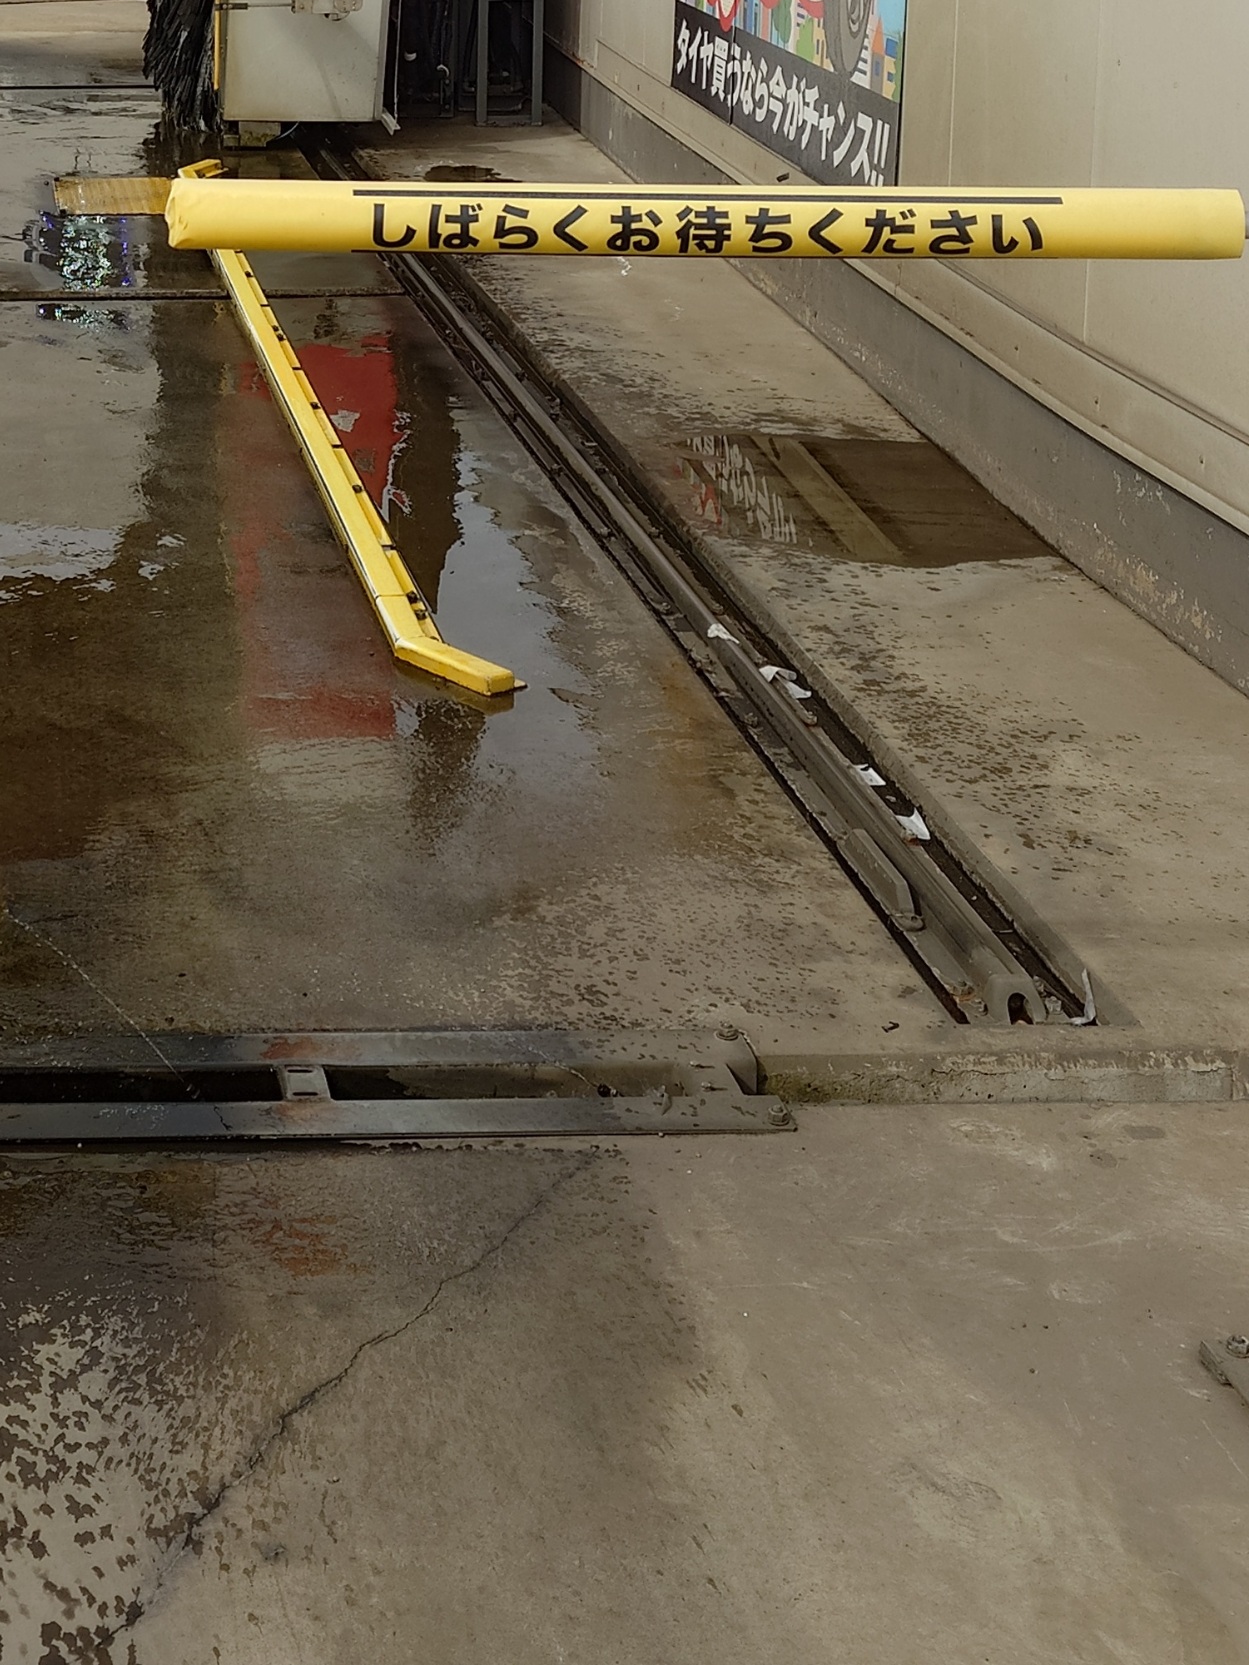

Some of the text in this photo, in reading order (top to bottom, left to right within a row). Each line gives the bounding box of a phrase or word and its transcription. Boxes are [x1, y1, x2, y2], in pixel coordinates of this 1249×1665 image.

[370, 202, 1045, 256] しばらくお待ちください
